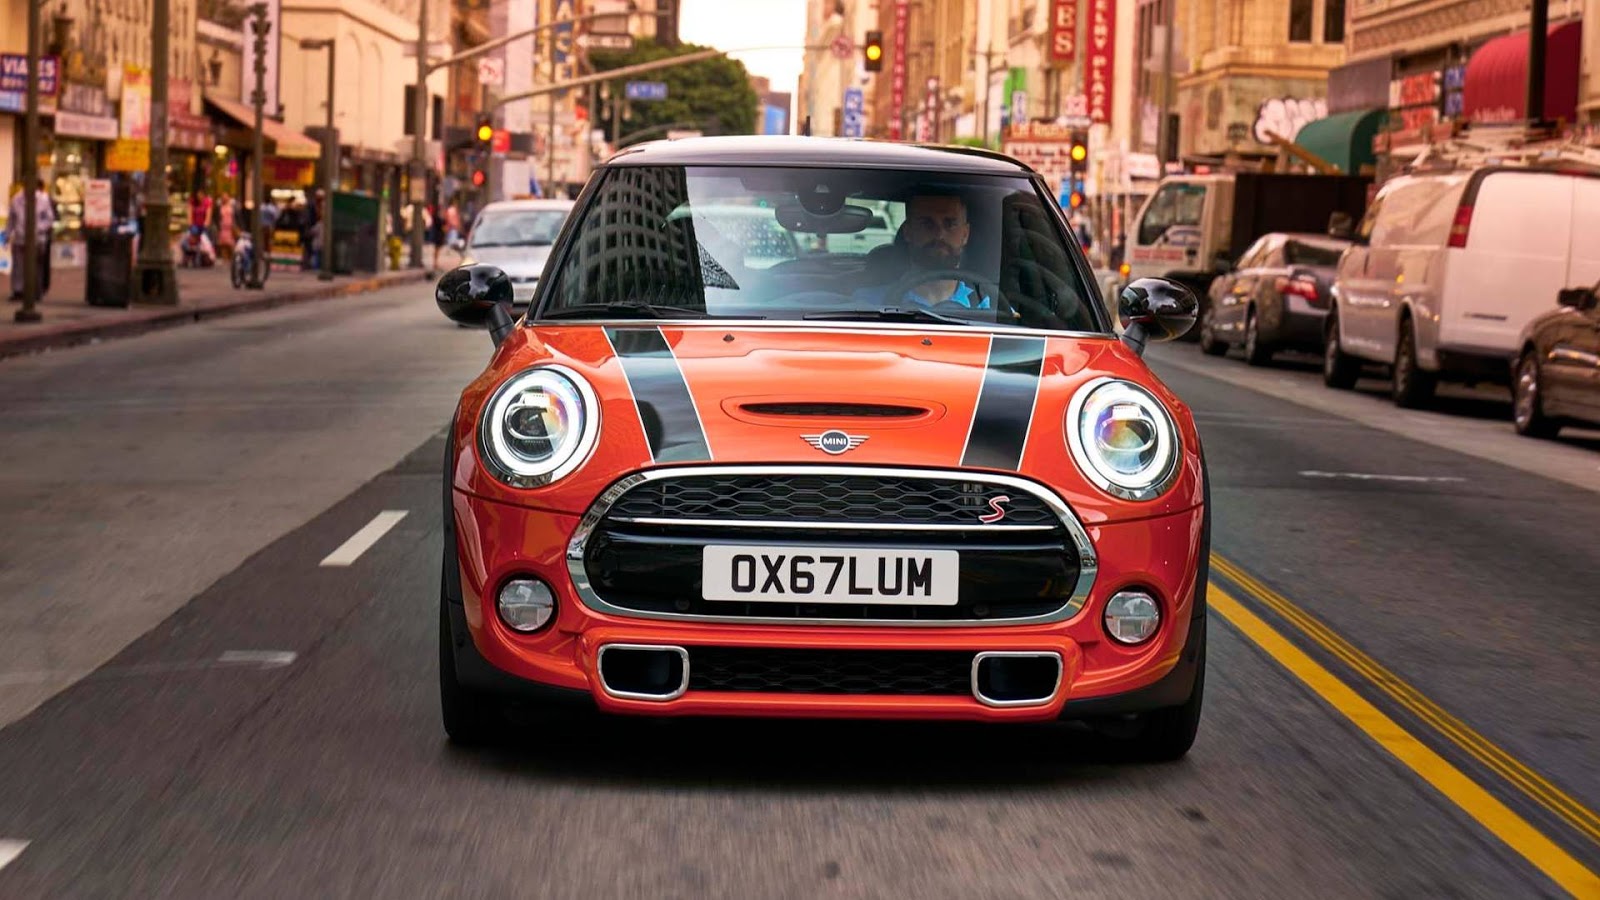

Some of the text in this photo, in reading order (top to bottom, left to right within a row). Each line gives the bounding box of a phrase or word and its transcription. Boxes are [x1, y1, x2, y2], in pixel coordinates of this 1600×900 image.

[3, 57, 56, 77] VIAES
[1091, 55, 1107, 120] PLAZA
[822, 437, 847, 446] MINI
[978, 494, 1011, 524] S
[731, 553, 933, 597] OX67LUM
